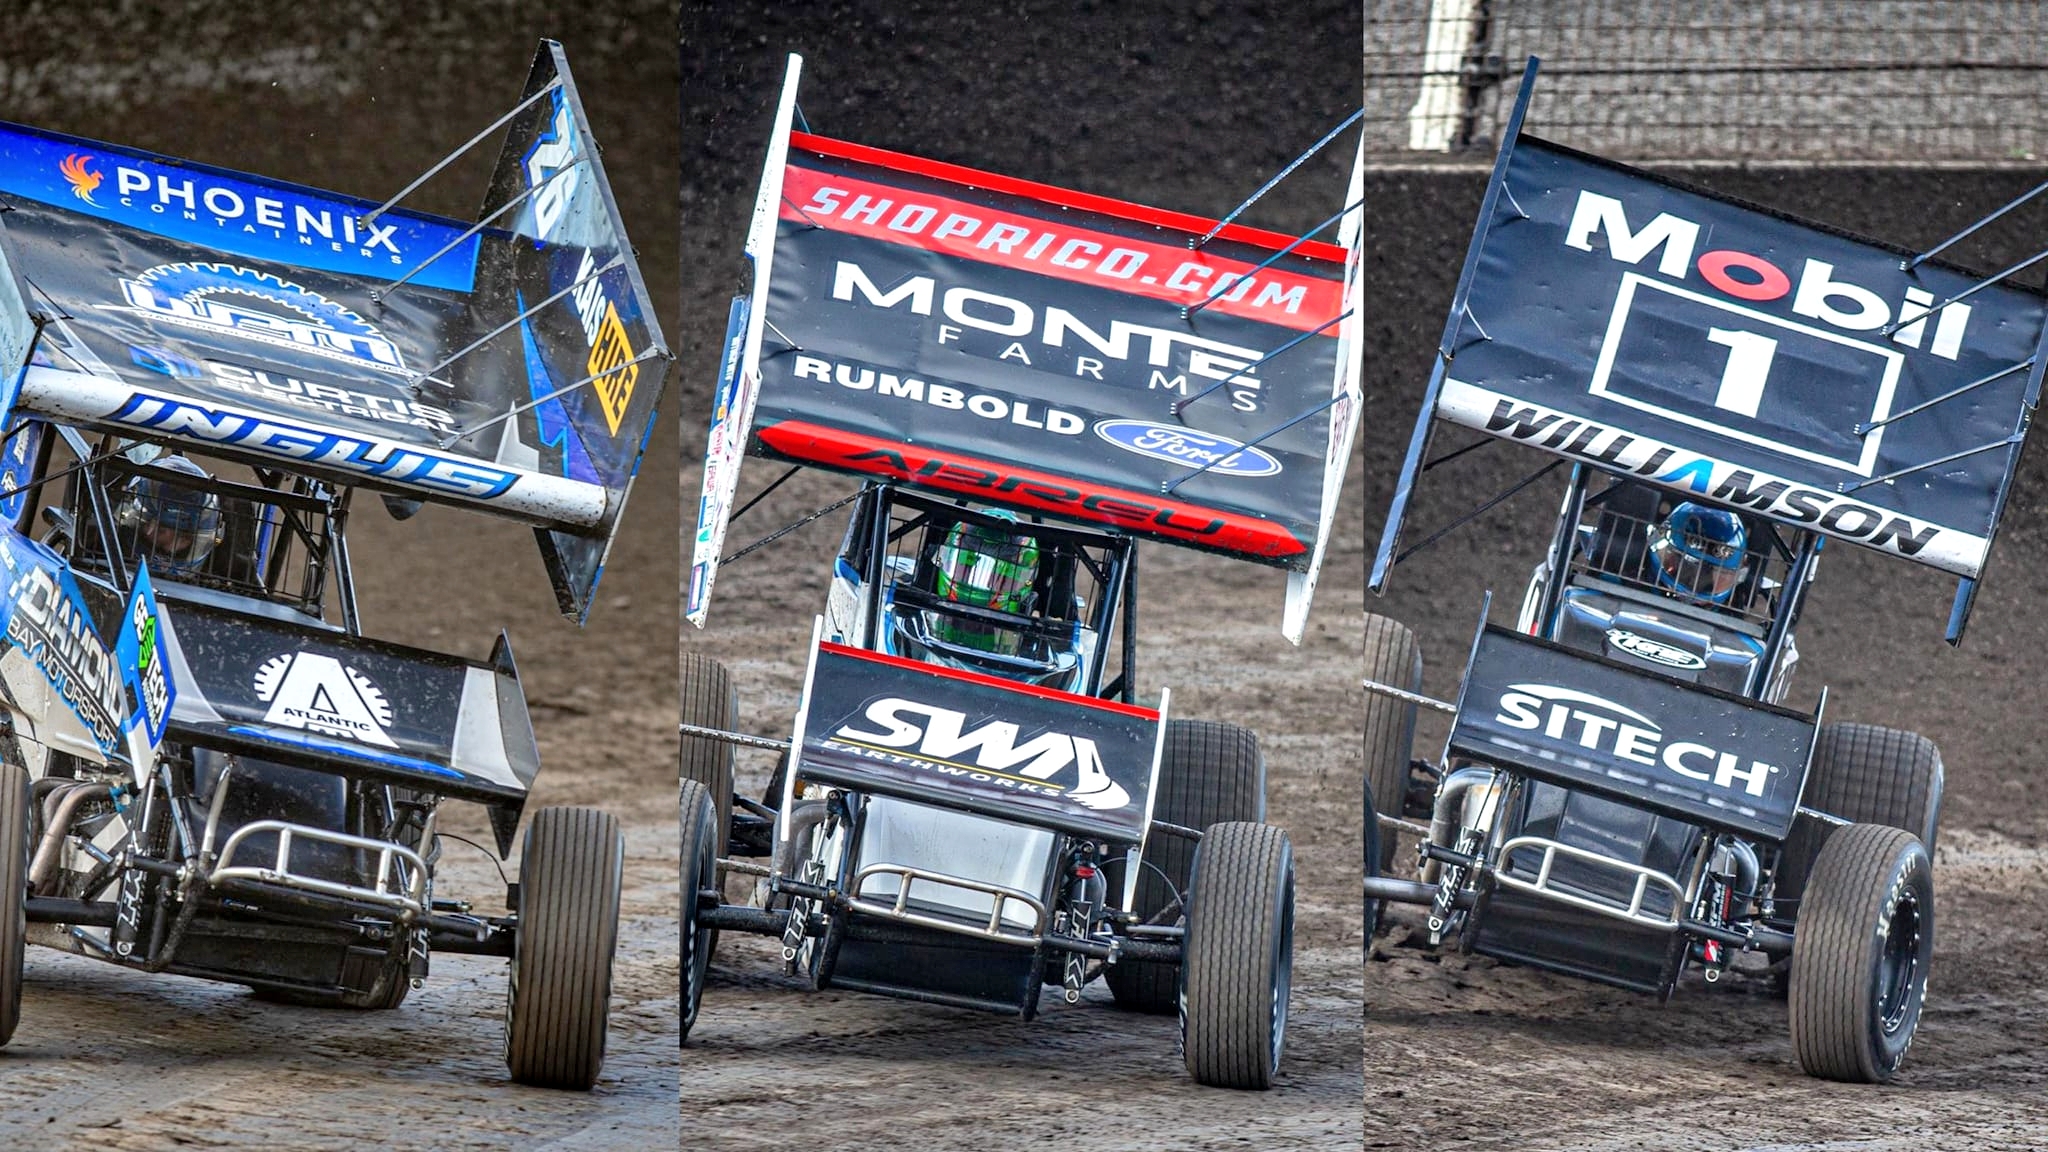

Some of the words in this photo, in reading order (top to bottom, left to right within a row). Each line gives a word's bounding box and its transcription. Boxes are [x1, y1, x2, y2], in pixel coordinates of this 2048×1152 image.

[117, 167, 401, 254] PHOENIX
[120, 197, 403, 265] CONTAINERS
[803, 186, 1309, 315] SHOPRICO.COM
[832, 260, 1265, 388] MONTE
[1564, 190, 1973, 361] Mobil
[209, 359, 455, 424] CURTIS
[216, 376, 461, 435] ELECTRICAL
[794, 356, 1086, 436] RUMBOLD
[1133, 428, 1243, 468] Ford
[939, 326, 1257, 413] FARMS
[1707, 327, 1778, 418] 1
[118, 393, 518, 499] INGLIS
[845, 448, 1225, 535] ABREU
[1484, 399, 1940, 555] WILLIAMSON
[7, 614, 42, 654] BAY
[38, 645, 118, 750] MOTORSPORT
[18, 566, 123, 728] DIAMOND
[283, 707, 371, 732] ATLANTIC
[820, 740, 1068, 797] EARTHWORKS
[1495, 691, 1770, 797] SITECH
